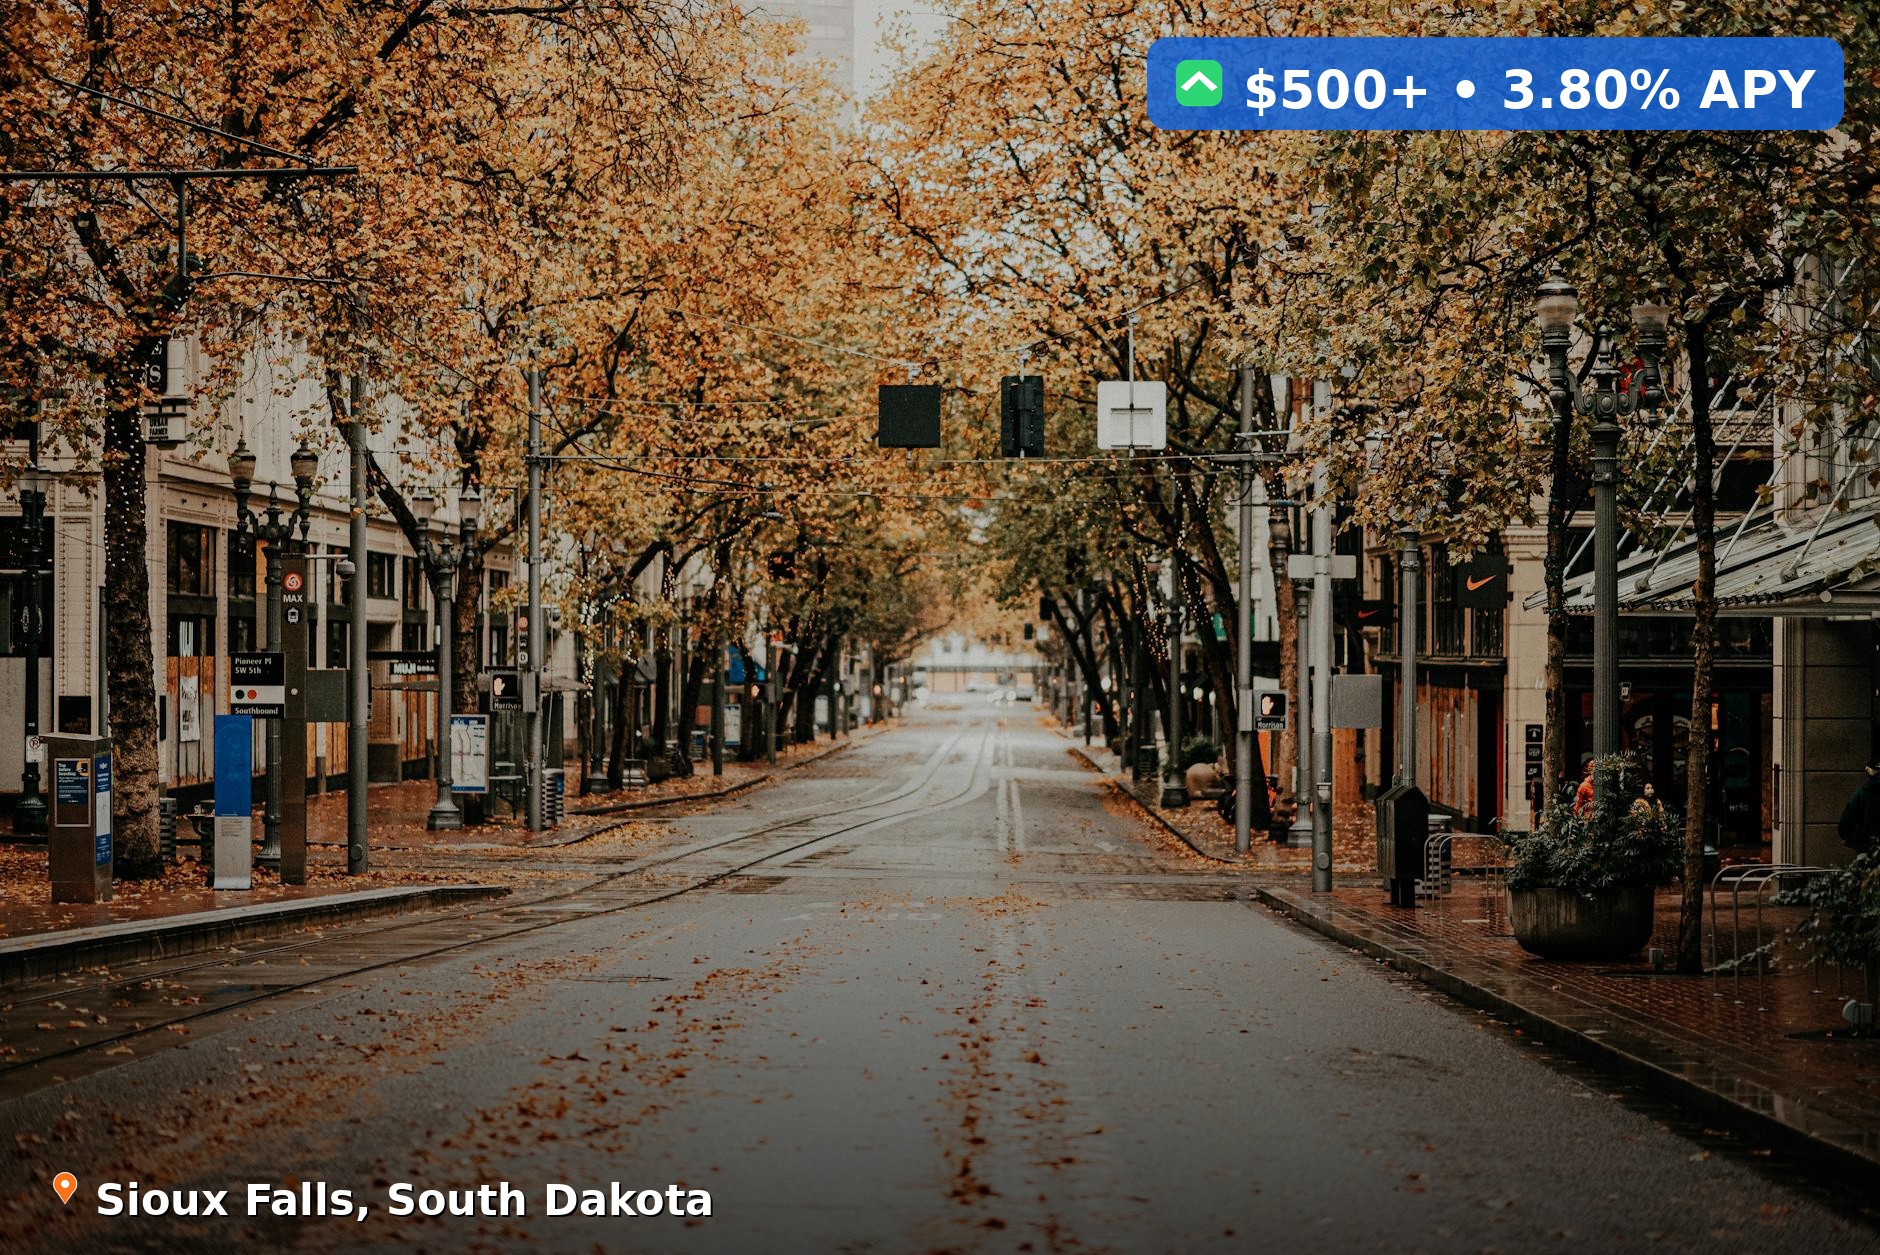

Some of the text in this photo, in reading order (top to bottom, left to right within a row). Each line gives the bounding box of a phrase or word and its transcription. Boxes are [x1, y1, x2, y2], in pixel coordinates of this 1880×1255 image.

[283, 594, 303, 603] MAX
[235, 657, 262, 665] Pioneer
[394, 663, 417, 674] MUJI
[494, 702, 521, 710] Morrison
[235, 706, 279, 715] Southbound
[1257, 721, 1284, 729] Morrison
